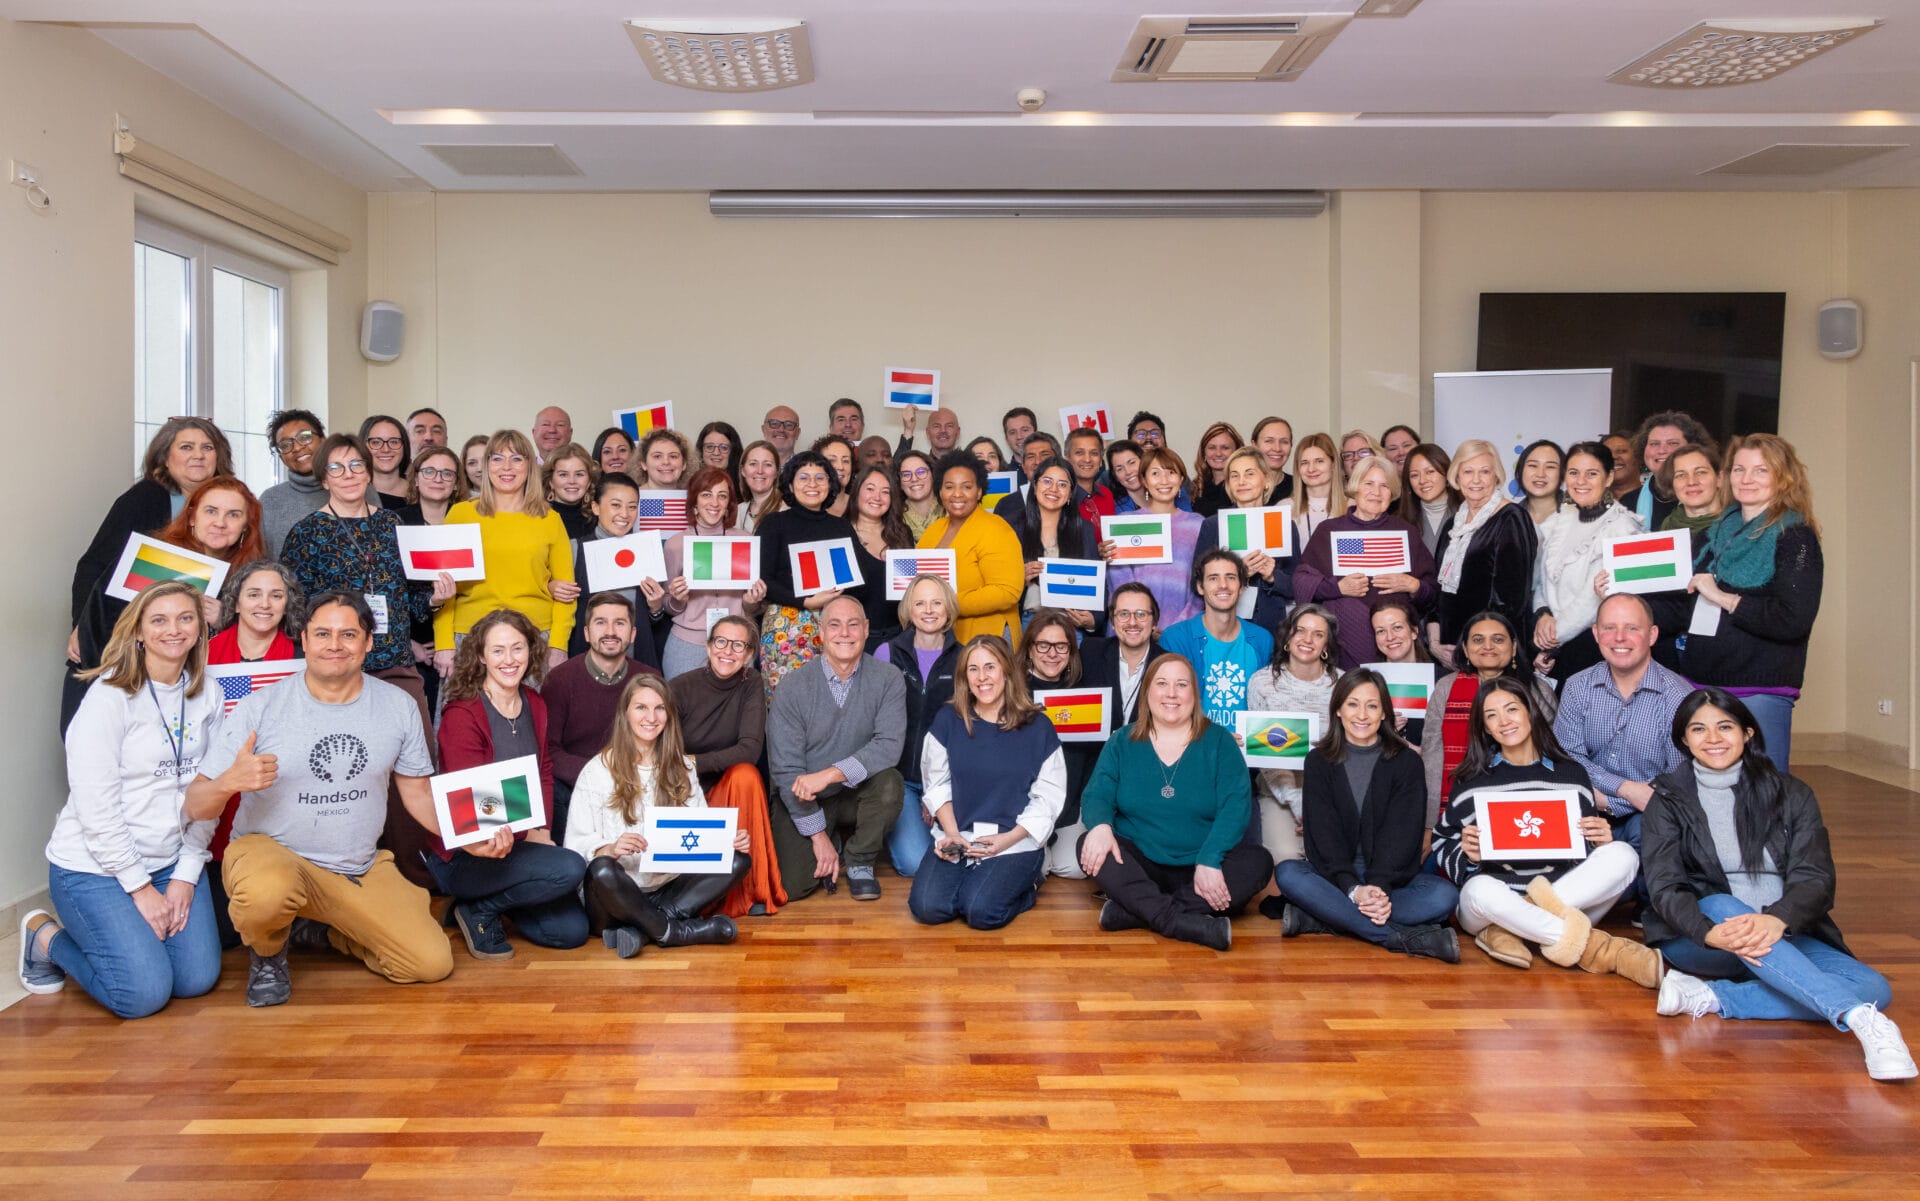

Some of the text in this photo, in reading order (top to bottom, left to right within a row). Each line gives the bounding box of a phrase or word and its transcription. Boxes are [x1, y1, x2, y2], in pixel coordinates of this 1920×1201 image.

[153, 768, 168, 777] OF
[298, 789, 368, 804] HandsOn
[317, 807, 350, 816] MEXICO
